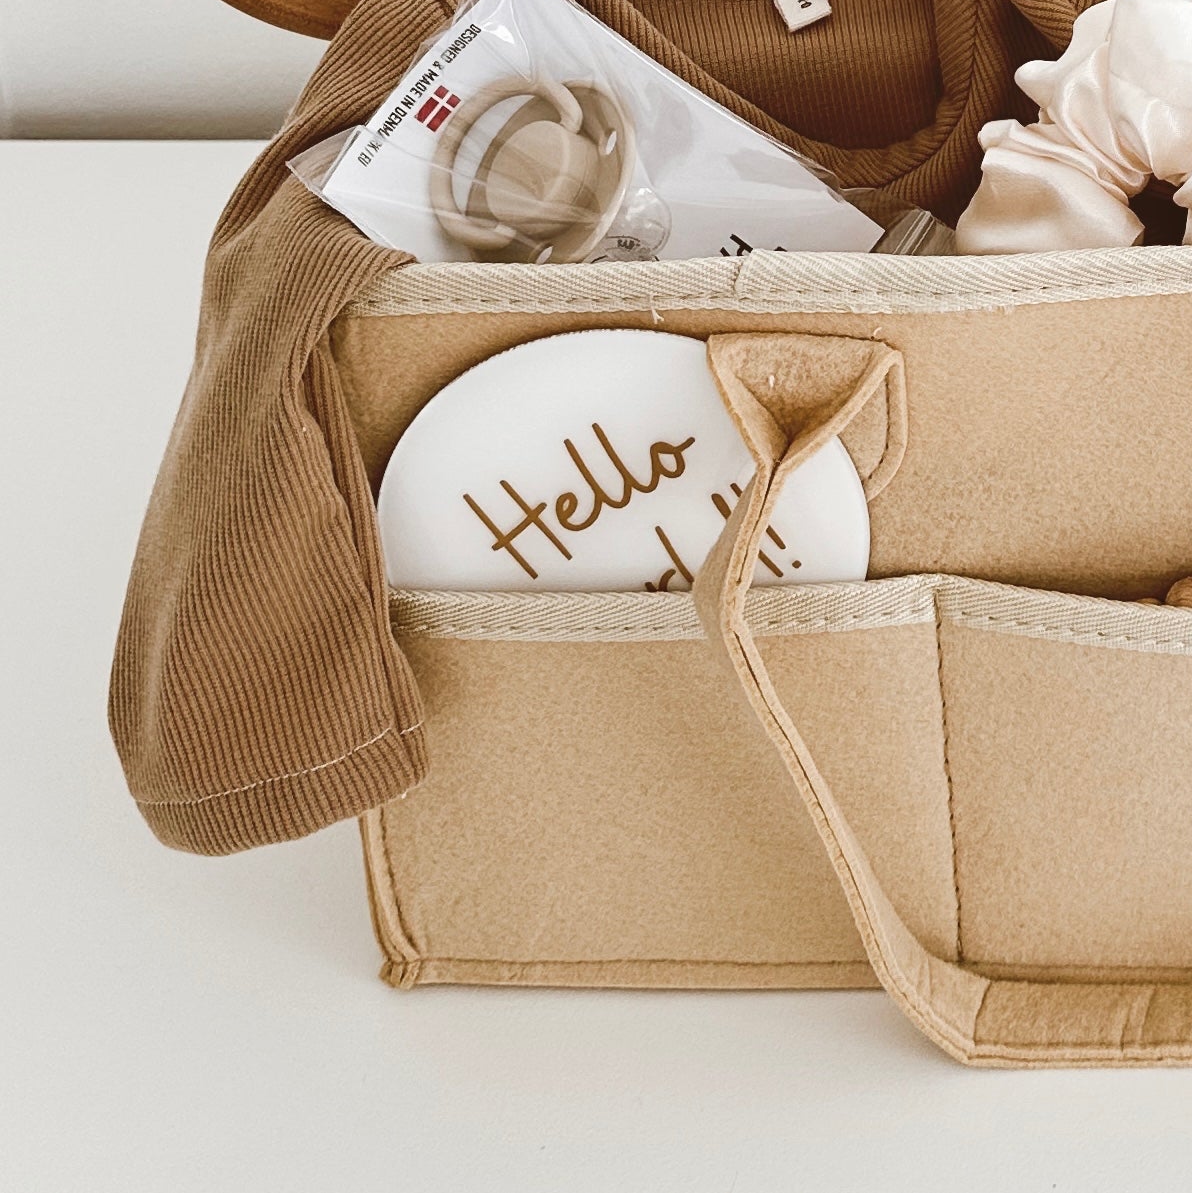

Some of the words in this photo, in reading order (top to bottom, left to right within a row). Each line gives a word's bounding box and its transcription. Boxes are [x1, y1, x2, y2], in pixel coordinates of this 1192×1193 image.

[440, 23, 482, 64] DESIGNED
[409, 68, 440, 98] MADE
[400, 94, 417, 110] IN
[356, 151, 373, 168] EU
[462, 422, 697, 581] Hello
